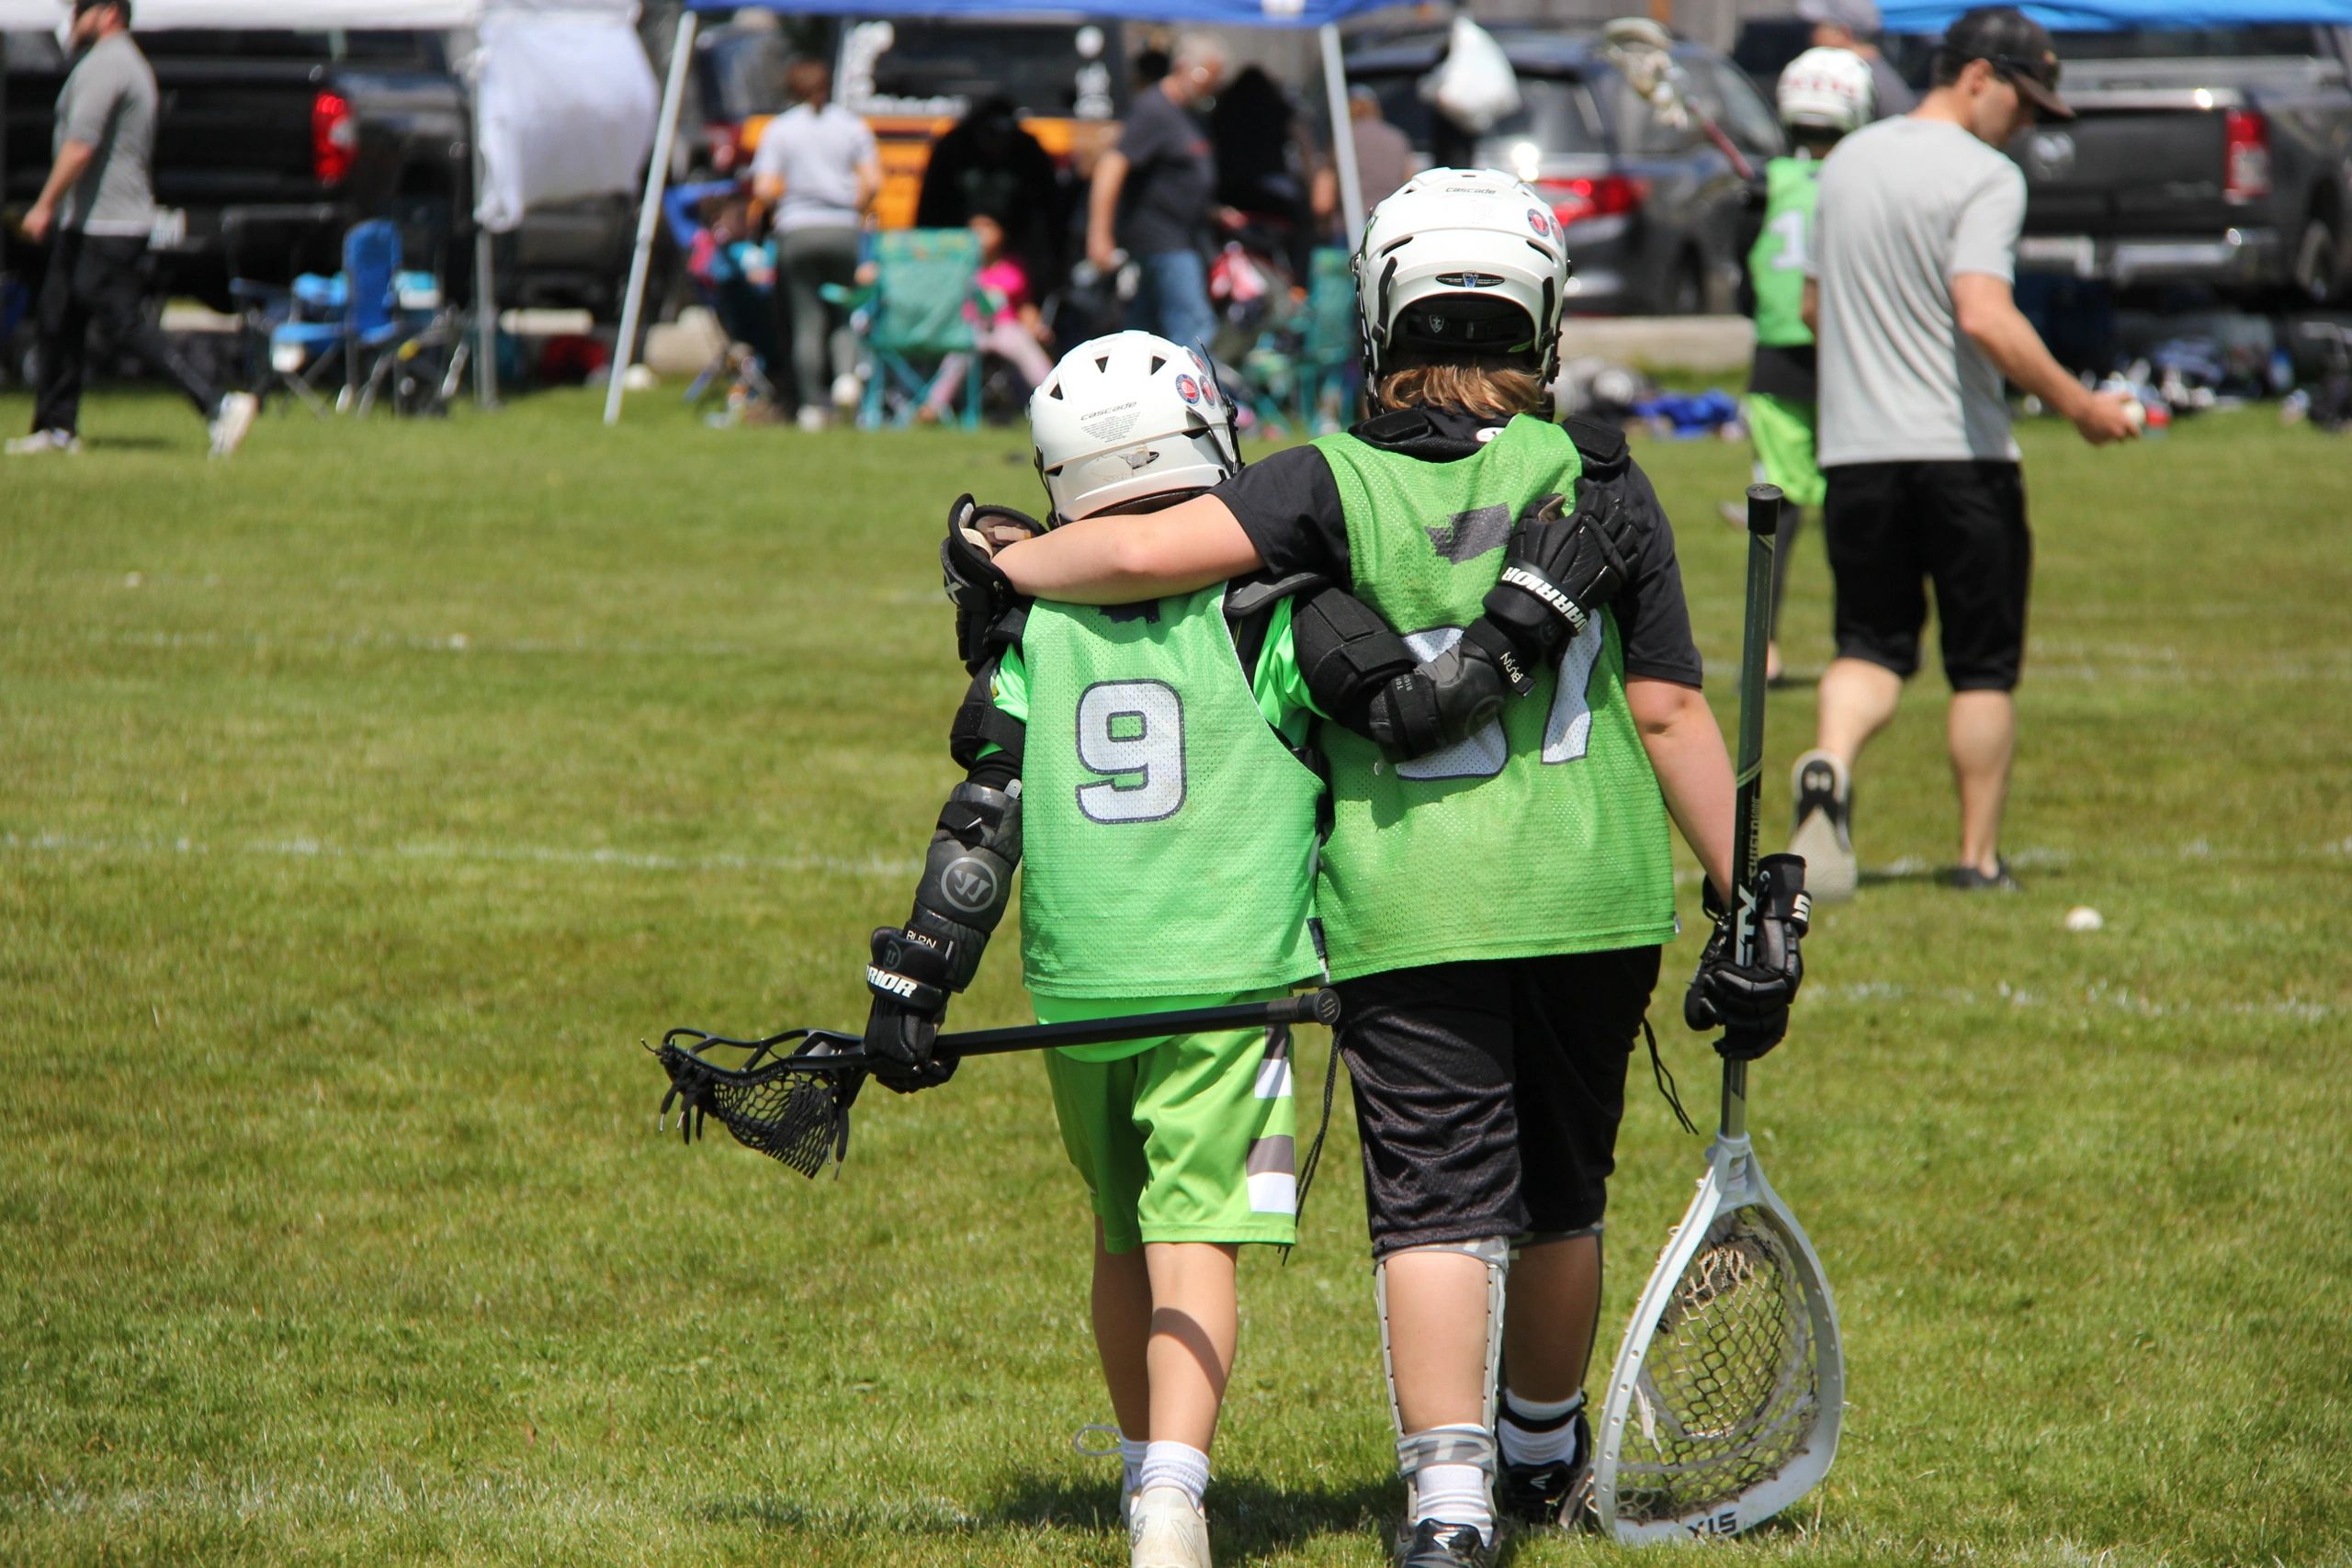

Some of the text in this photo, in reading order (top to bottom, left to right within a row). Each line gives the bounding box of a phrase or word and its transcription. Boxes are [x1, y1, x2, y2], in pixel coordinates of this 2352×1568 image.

[1445, 186, 1497, 196] cascade
[1080, 401, 1137, 421] cascade
[1500, 650, 1524, 683] BURN
[1075, 678, 1188, 825] 9
[866, 964, 918, 998] RIOR
